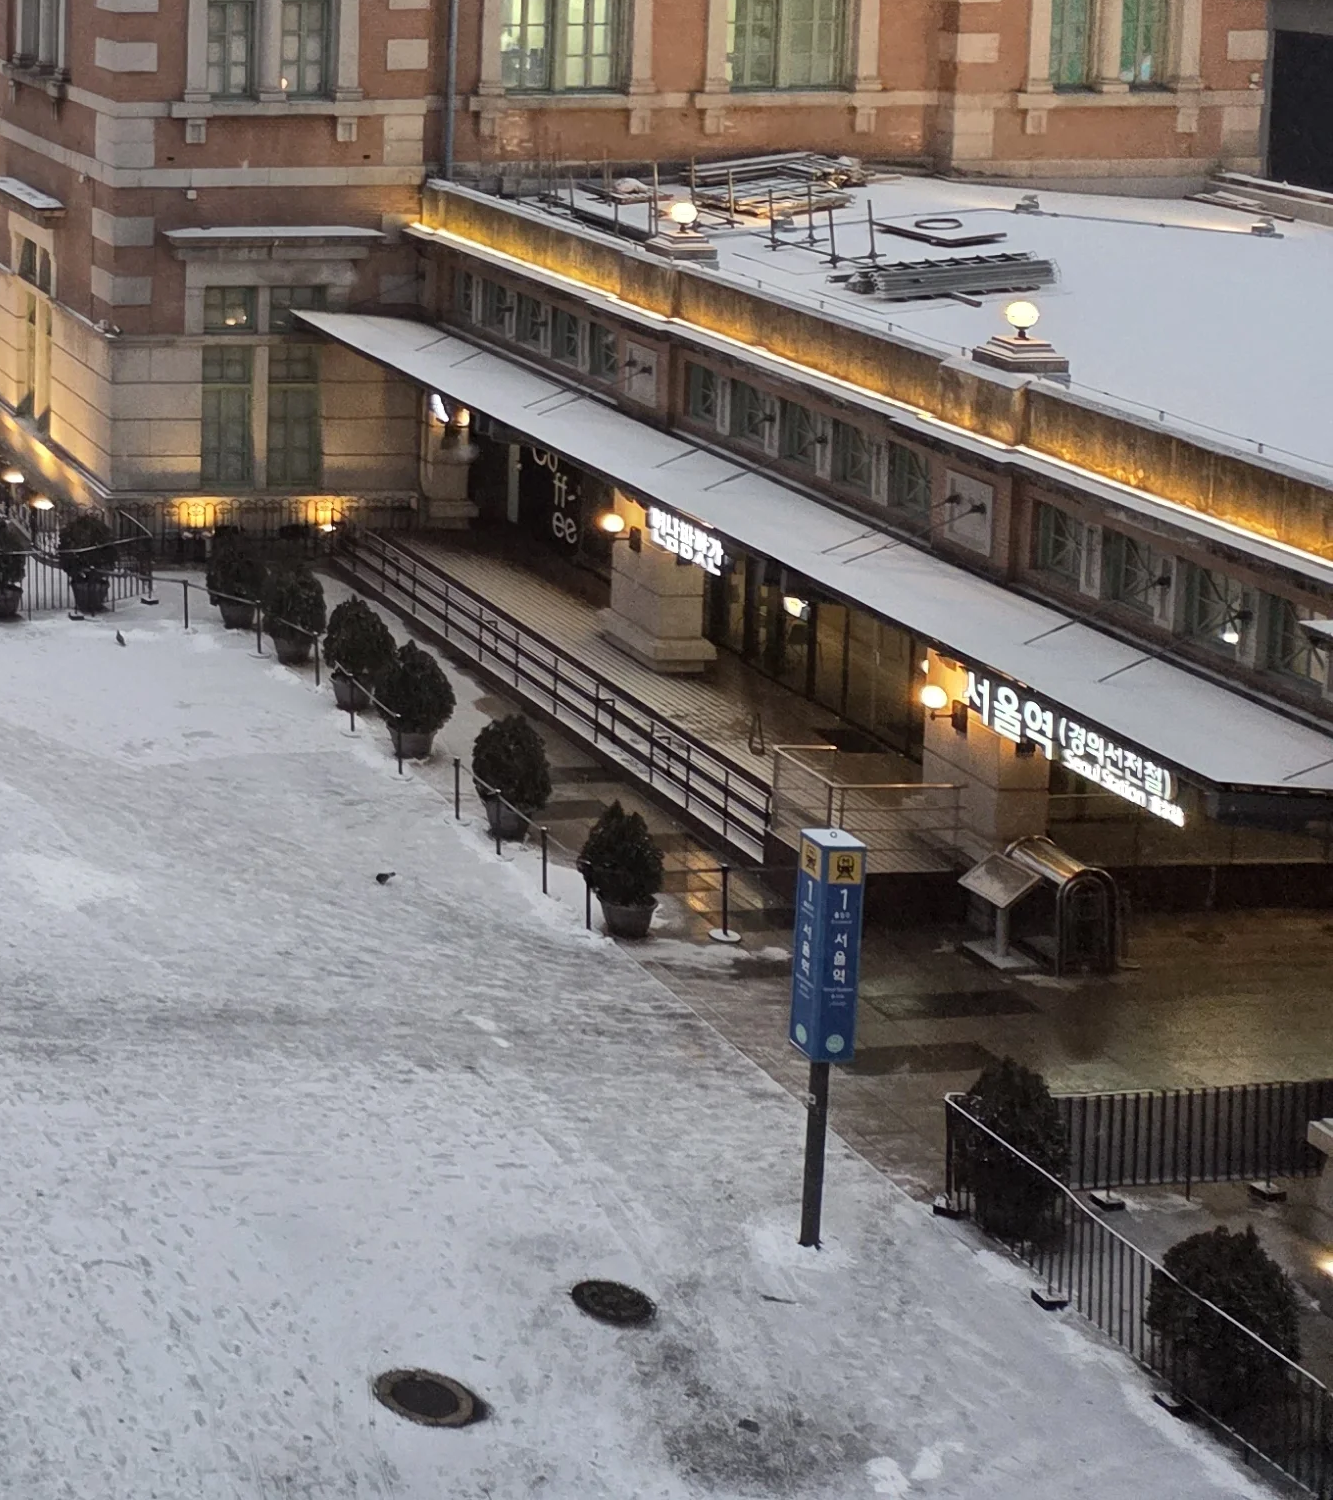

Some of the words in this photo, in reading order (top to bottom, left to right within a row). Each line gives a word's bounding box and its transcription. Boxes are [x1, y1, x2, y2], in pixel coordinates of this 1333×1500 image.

[552, 512, 577, 544] ee
[963, 671, 1053, 761] 서울역
[1059, 717, 1170, 801] (경의선전철)
[1062, 748, 1101, 784] Seoul
[1100, 767, 1147, 808] Station
[807, 880, 813, 902] 1
[840, 888, 848, 911] 1
[833, 932, 848, 984] 서울역
